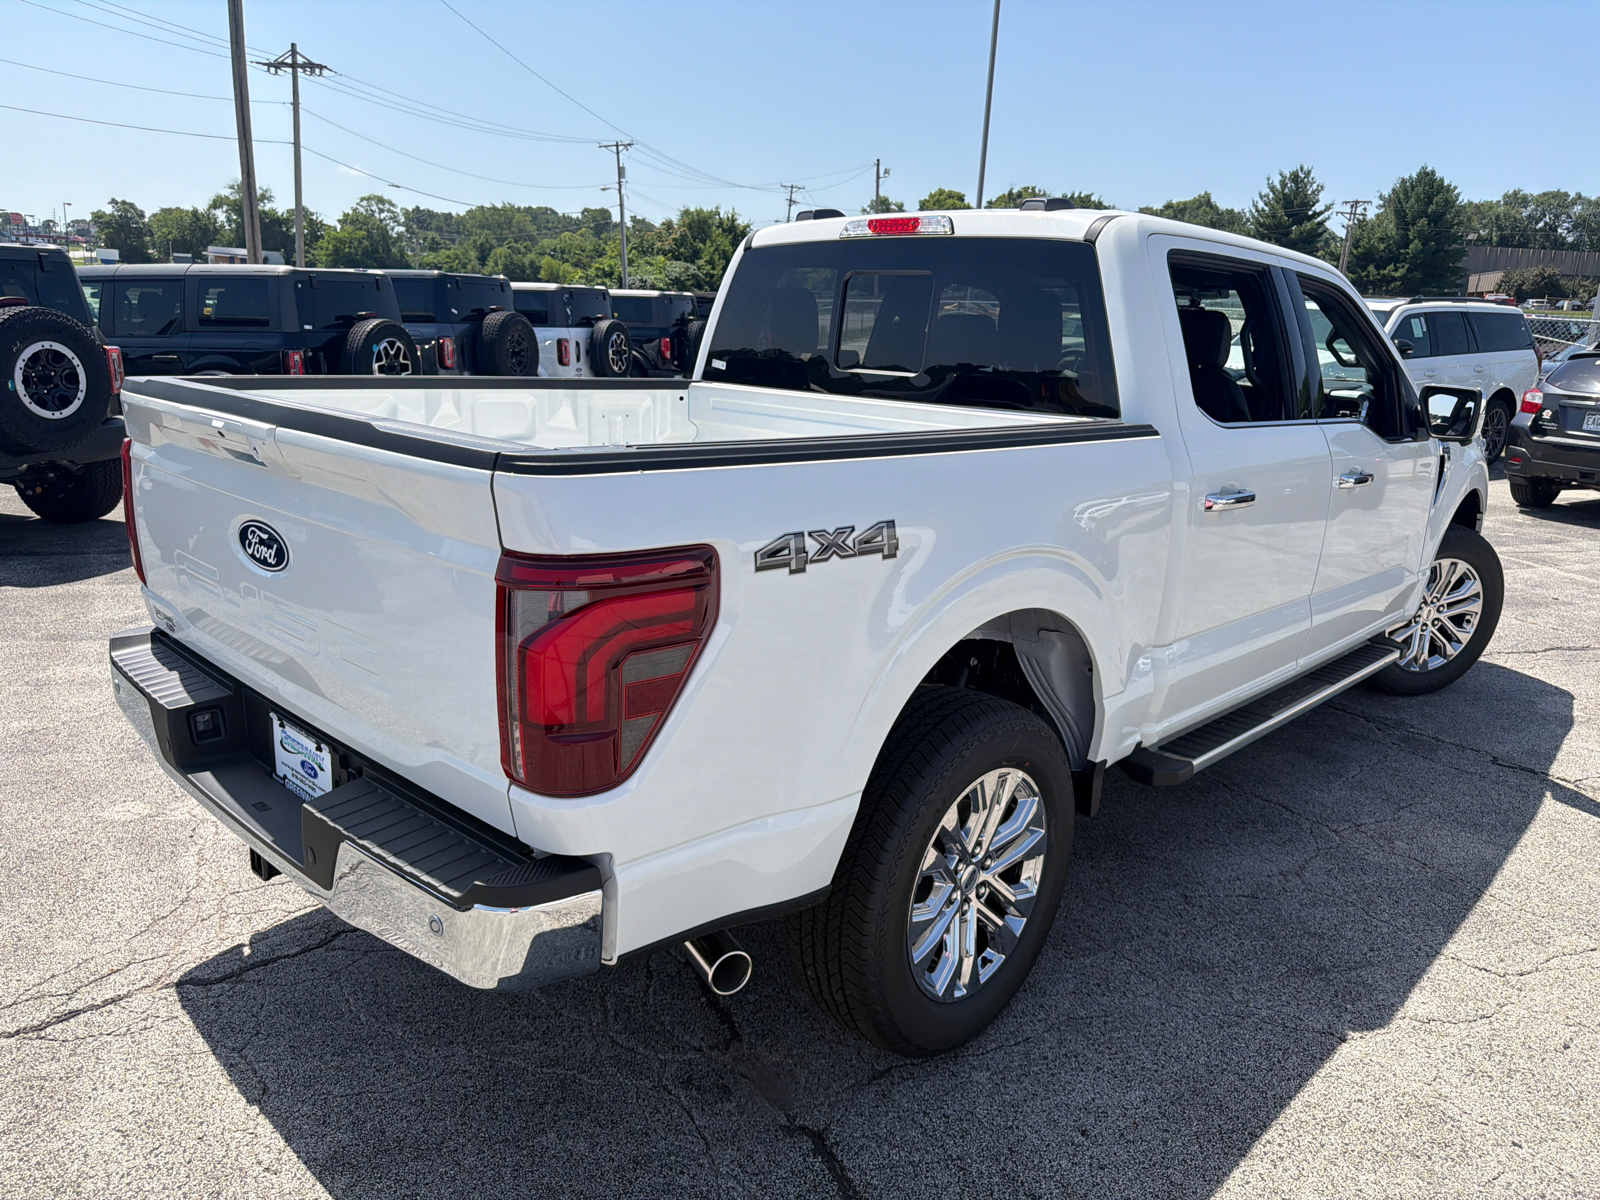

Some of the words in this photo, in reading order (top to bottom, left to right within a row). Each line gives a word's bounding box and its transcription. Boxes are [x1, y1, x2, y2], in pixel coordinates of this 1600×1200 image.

[245, 526, 277, 565] Ford
[303, 761, 315, 777] Ford
[284, 778, 314, 802] GREENW
